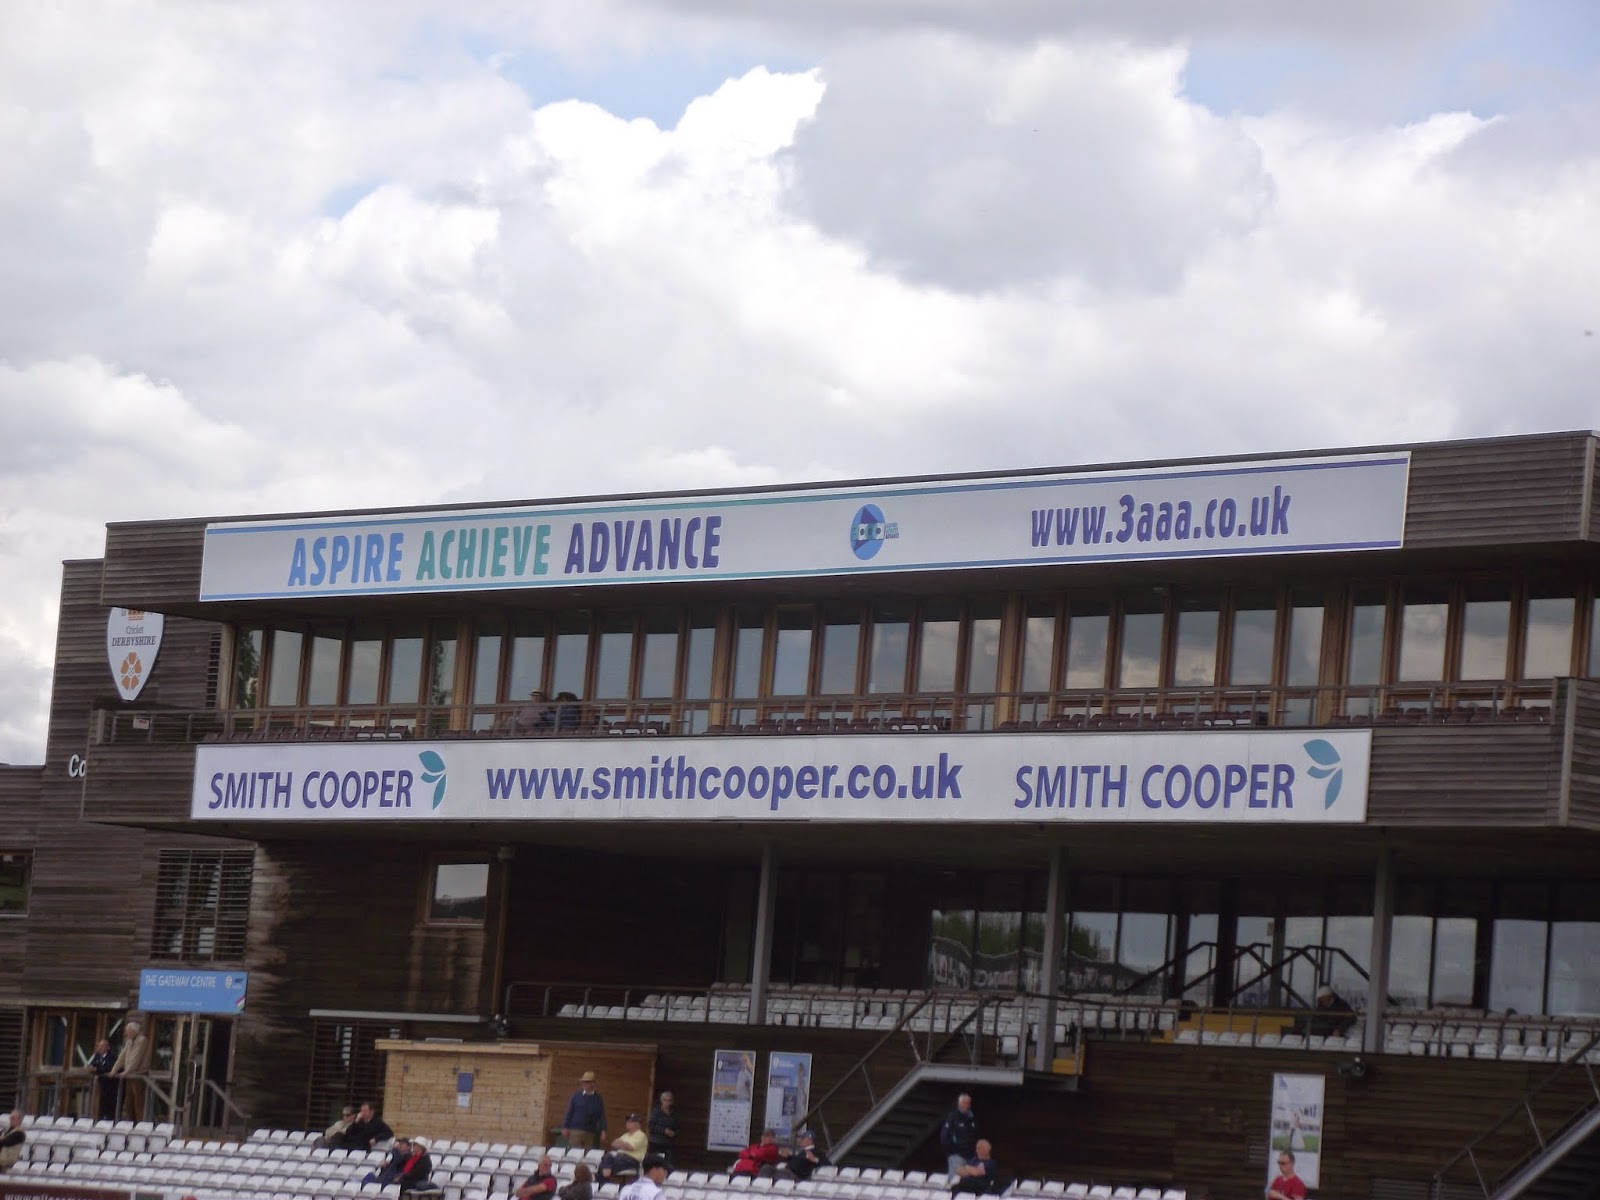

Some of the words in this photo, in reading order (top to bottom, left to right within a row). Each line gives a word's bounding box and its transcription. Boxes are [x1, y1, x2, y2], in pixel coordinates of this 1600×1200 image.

[1031, 485, 1292, 548] www.3aaa.co.uk
[287, 532, 405, 587] ASPIRE
[415, 524, 552, 581] ACHIEVE
[564, 515, 722, 574] ADVANCE
[111, 635, 157, 647] DERBYSHIRE
[125, 625, 144, 635] Cricket
[208, 771, 293, 809] SMITH
[302, 769, 414, 809] COOPER
[486, 753, 962, 812] www.smithcooper.co.uk
[1014, 765, 1127, 809] SMITH
[1141, 763, 1296, 809] COOPER
[145, 974, 157, 987] THE
[158, 975, 189, 987] GATEWAY
[190, 976, 217, 989] CENTRE
